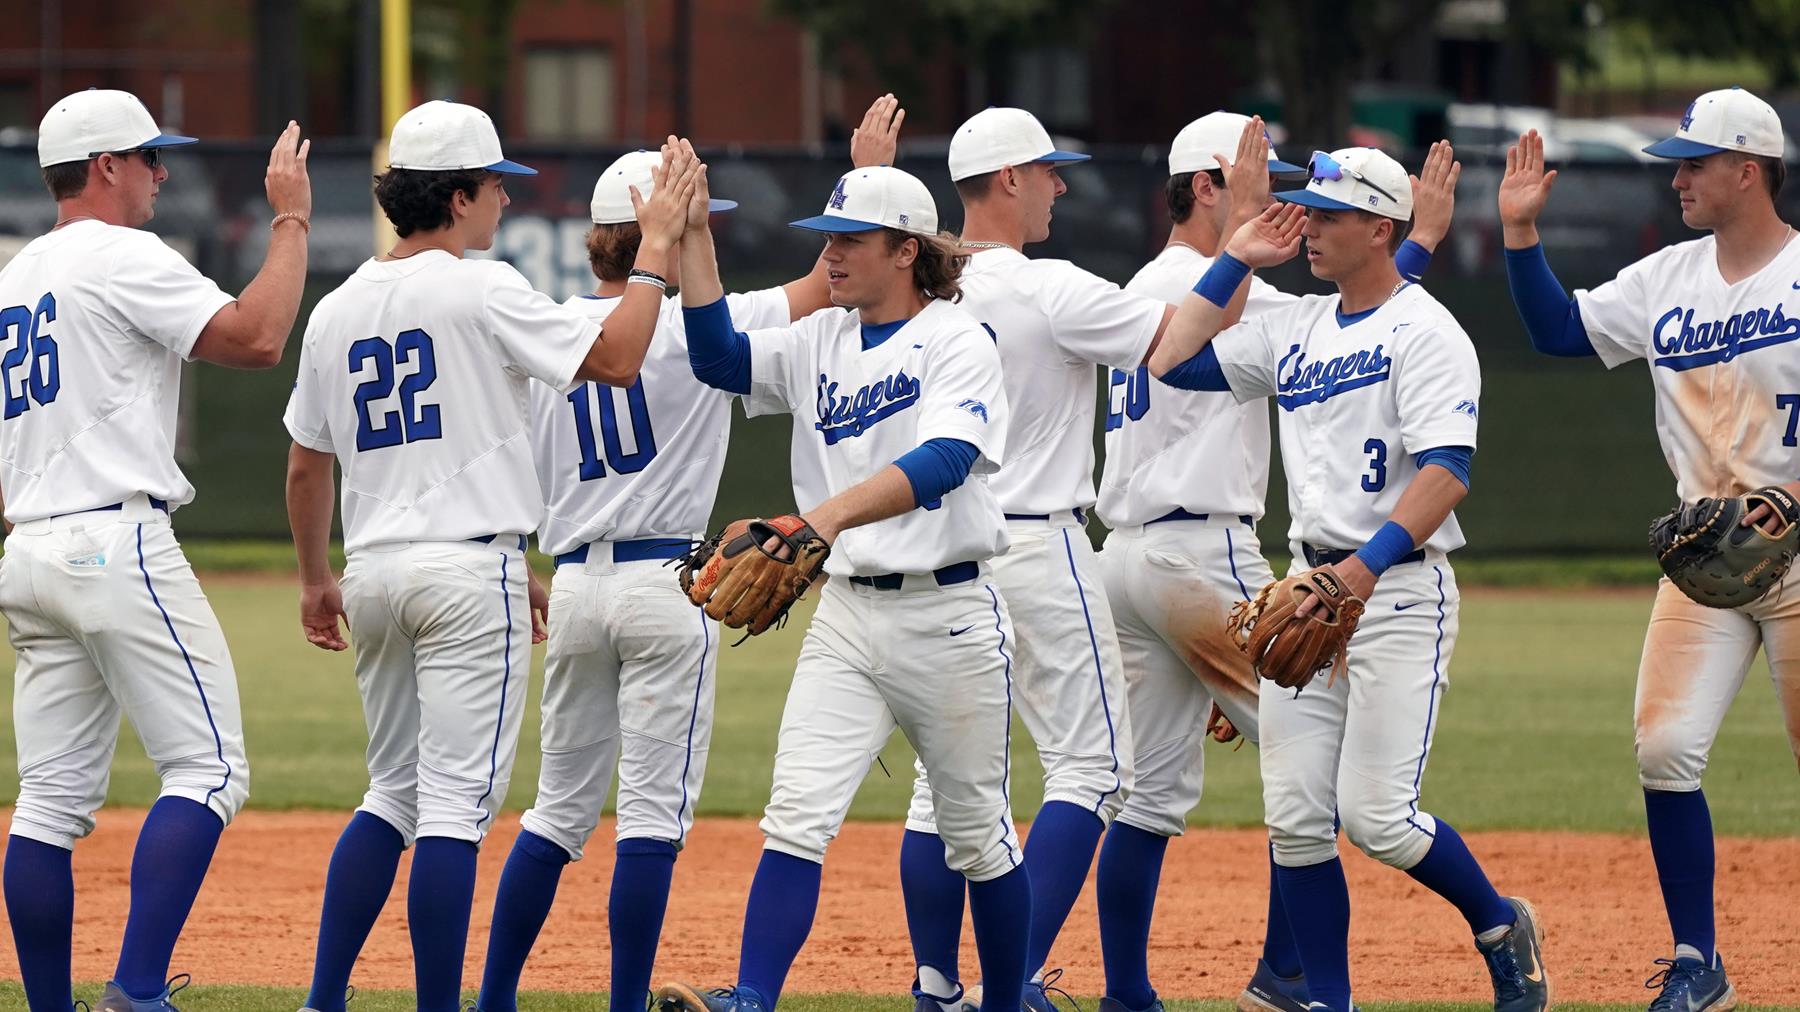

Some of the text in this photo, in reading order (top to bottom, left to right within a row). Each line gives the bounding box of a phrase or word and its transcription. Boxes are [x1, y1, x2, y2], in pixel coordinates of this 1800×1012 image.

[480, 215, 606, 300] 35
[0, 291, 61, 420] 26
[1653, 303, 1800, 372] Chargers
[348, 328, 442, 453] 22
[567, 372, 658, 482] 10
[1776, 394, 1800, 447] 7
[1361, 438, 1387, 492] 3
